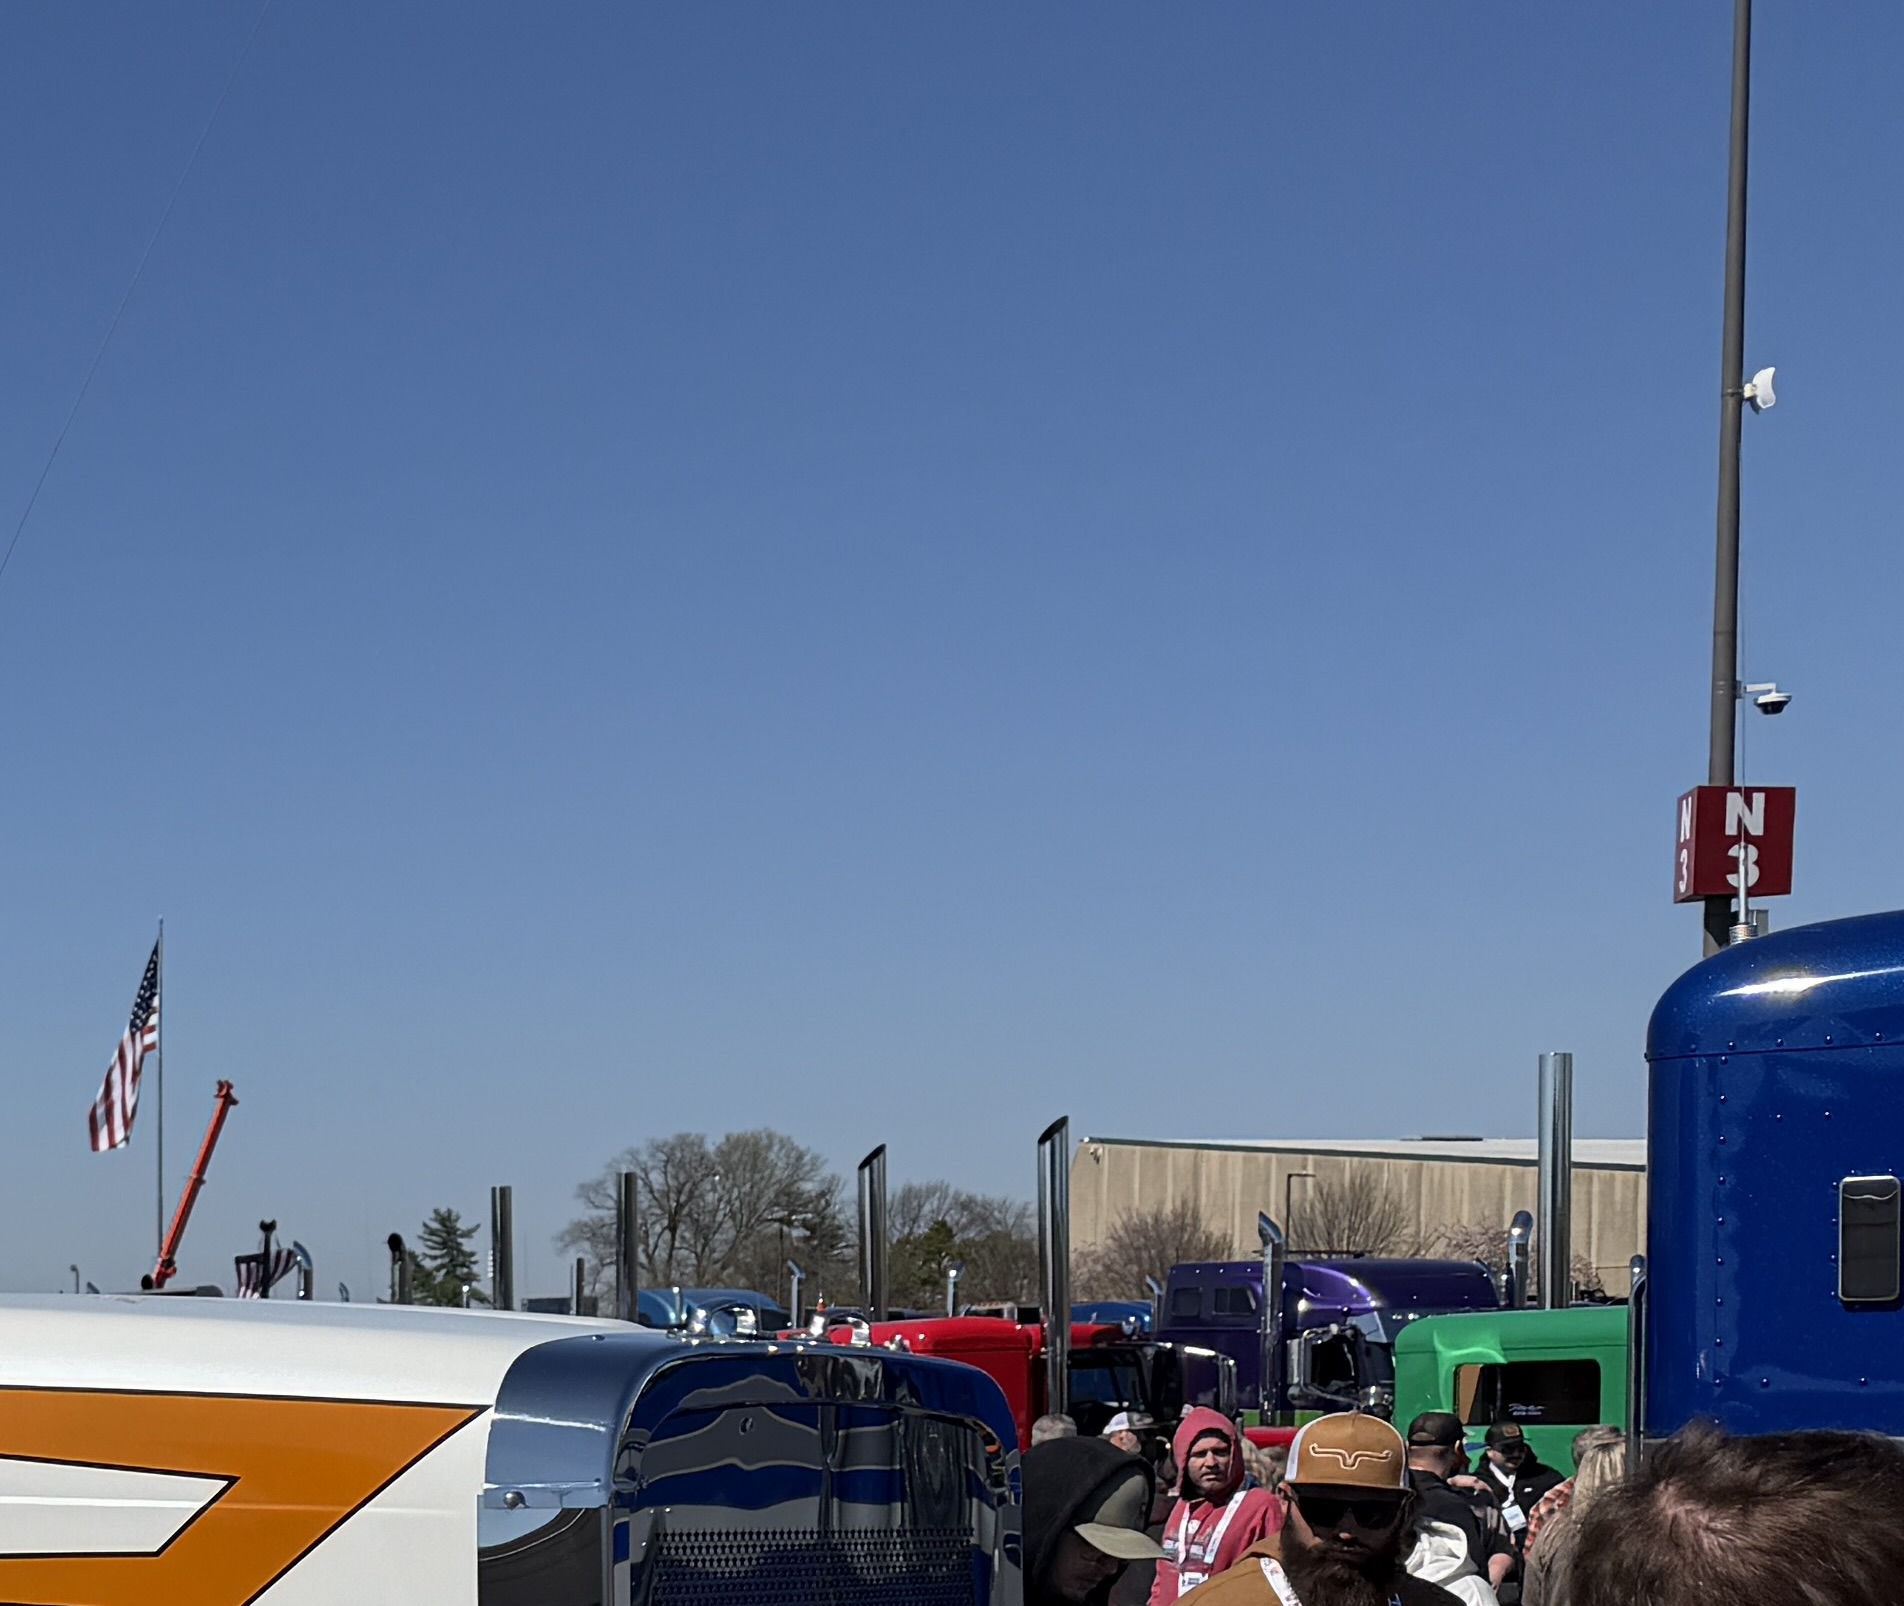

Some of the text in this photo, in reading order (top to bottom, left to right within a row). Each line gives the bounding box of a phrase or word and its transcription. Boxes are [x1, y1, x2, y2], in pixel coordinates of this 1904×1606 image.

[1680, 796, 1692, 842] N
[1725, 792, 1765, 835] N
[1679, 849, 1689, 892] 3
[1725, 844, 1760, 887] 3
